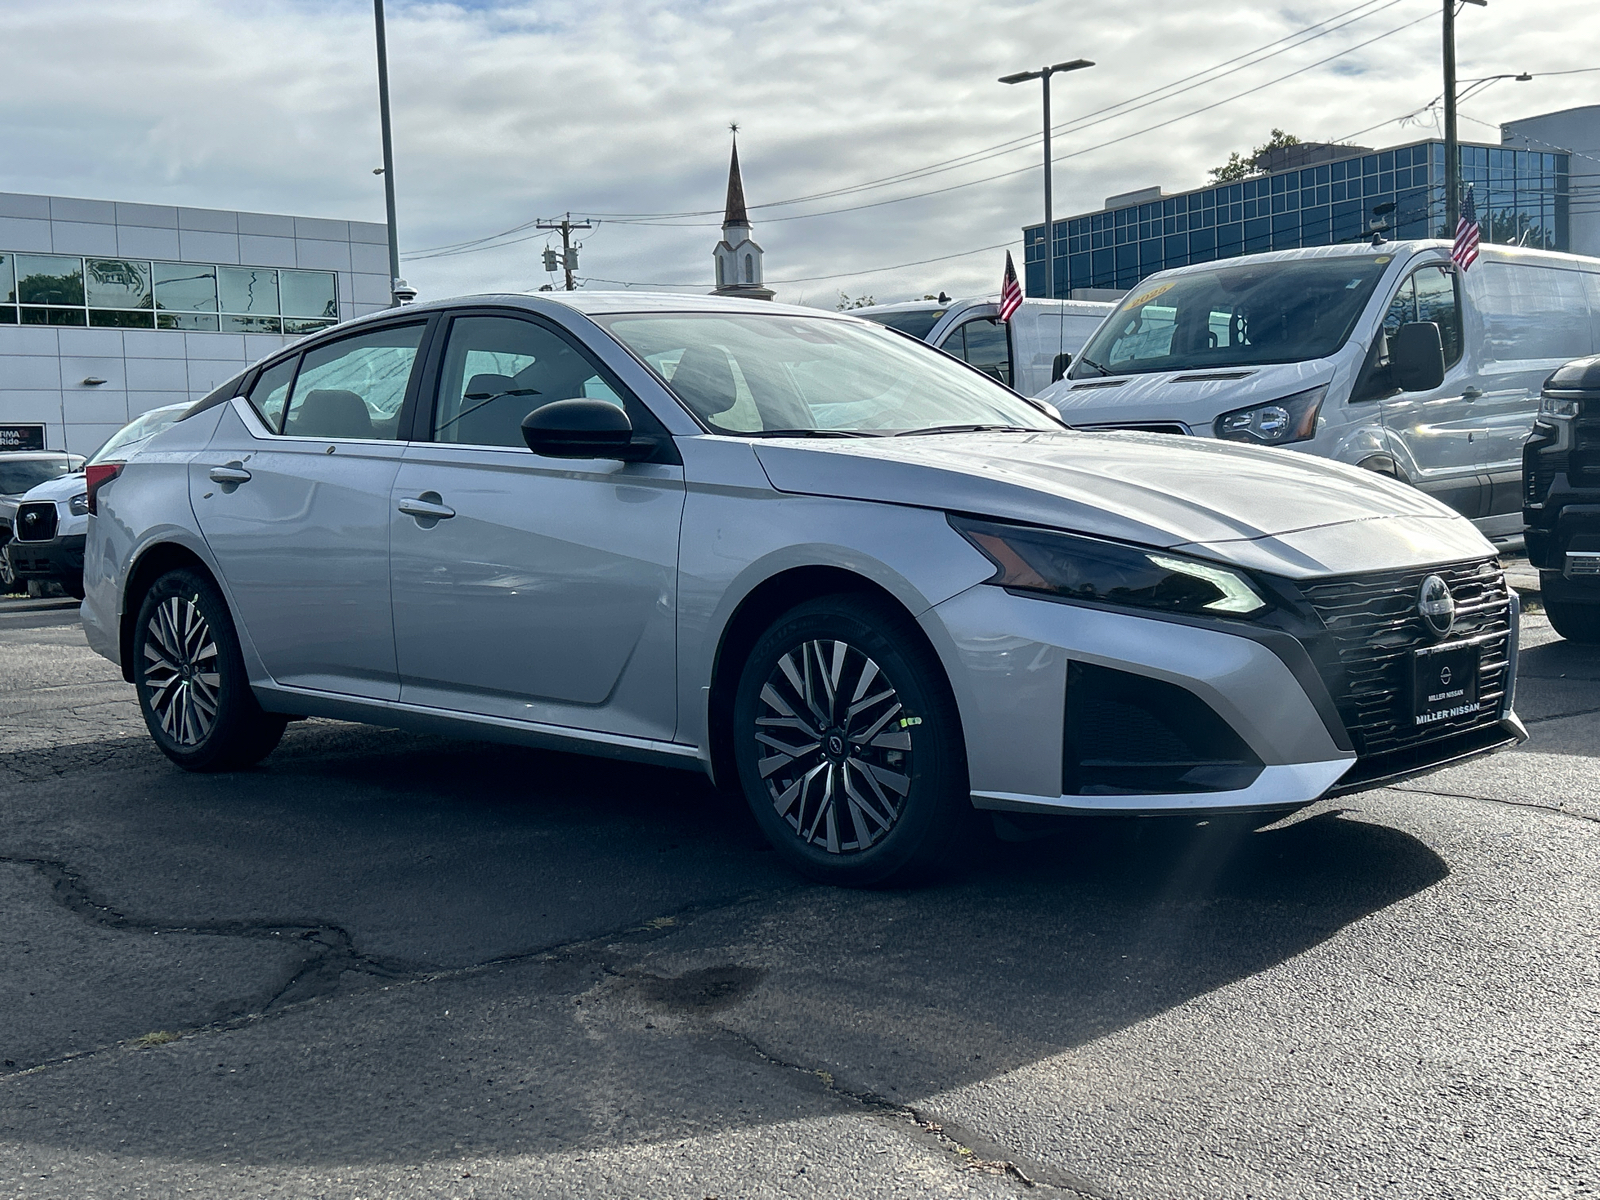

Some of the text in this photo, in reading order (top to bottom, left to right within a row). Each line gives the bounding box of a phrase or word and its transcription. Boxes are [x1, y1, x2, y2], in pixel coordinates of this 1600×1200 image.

[1132, 287, 1167, 307] 2025
[0, 438, 20, 446] Ride
[1418, 601, 1453, 614] NISS
[1428, 689, 1464, 702] MILLER NISSAN
[1416, 702, 1480, 725] MILLER NISSAN
